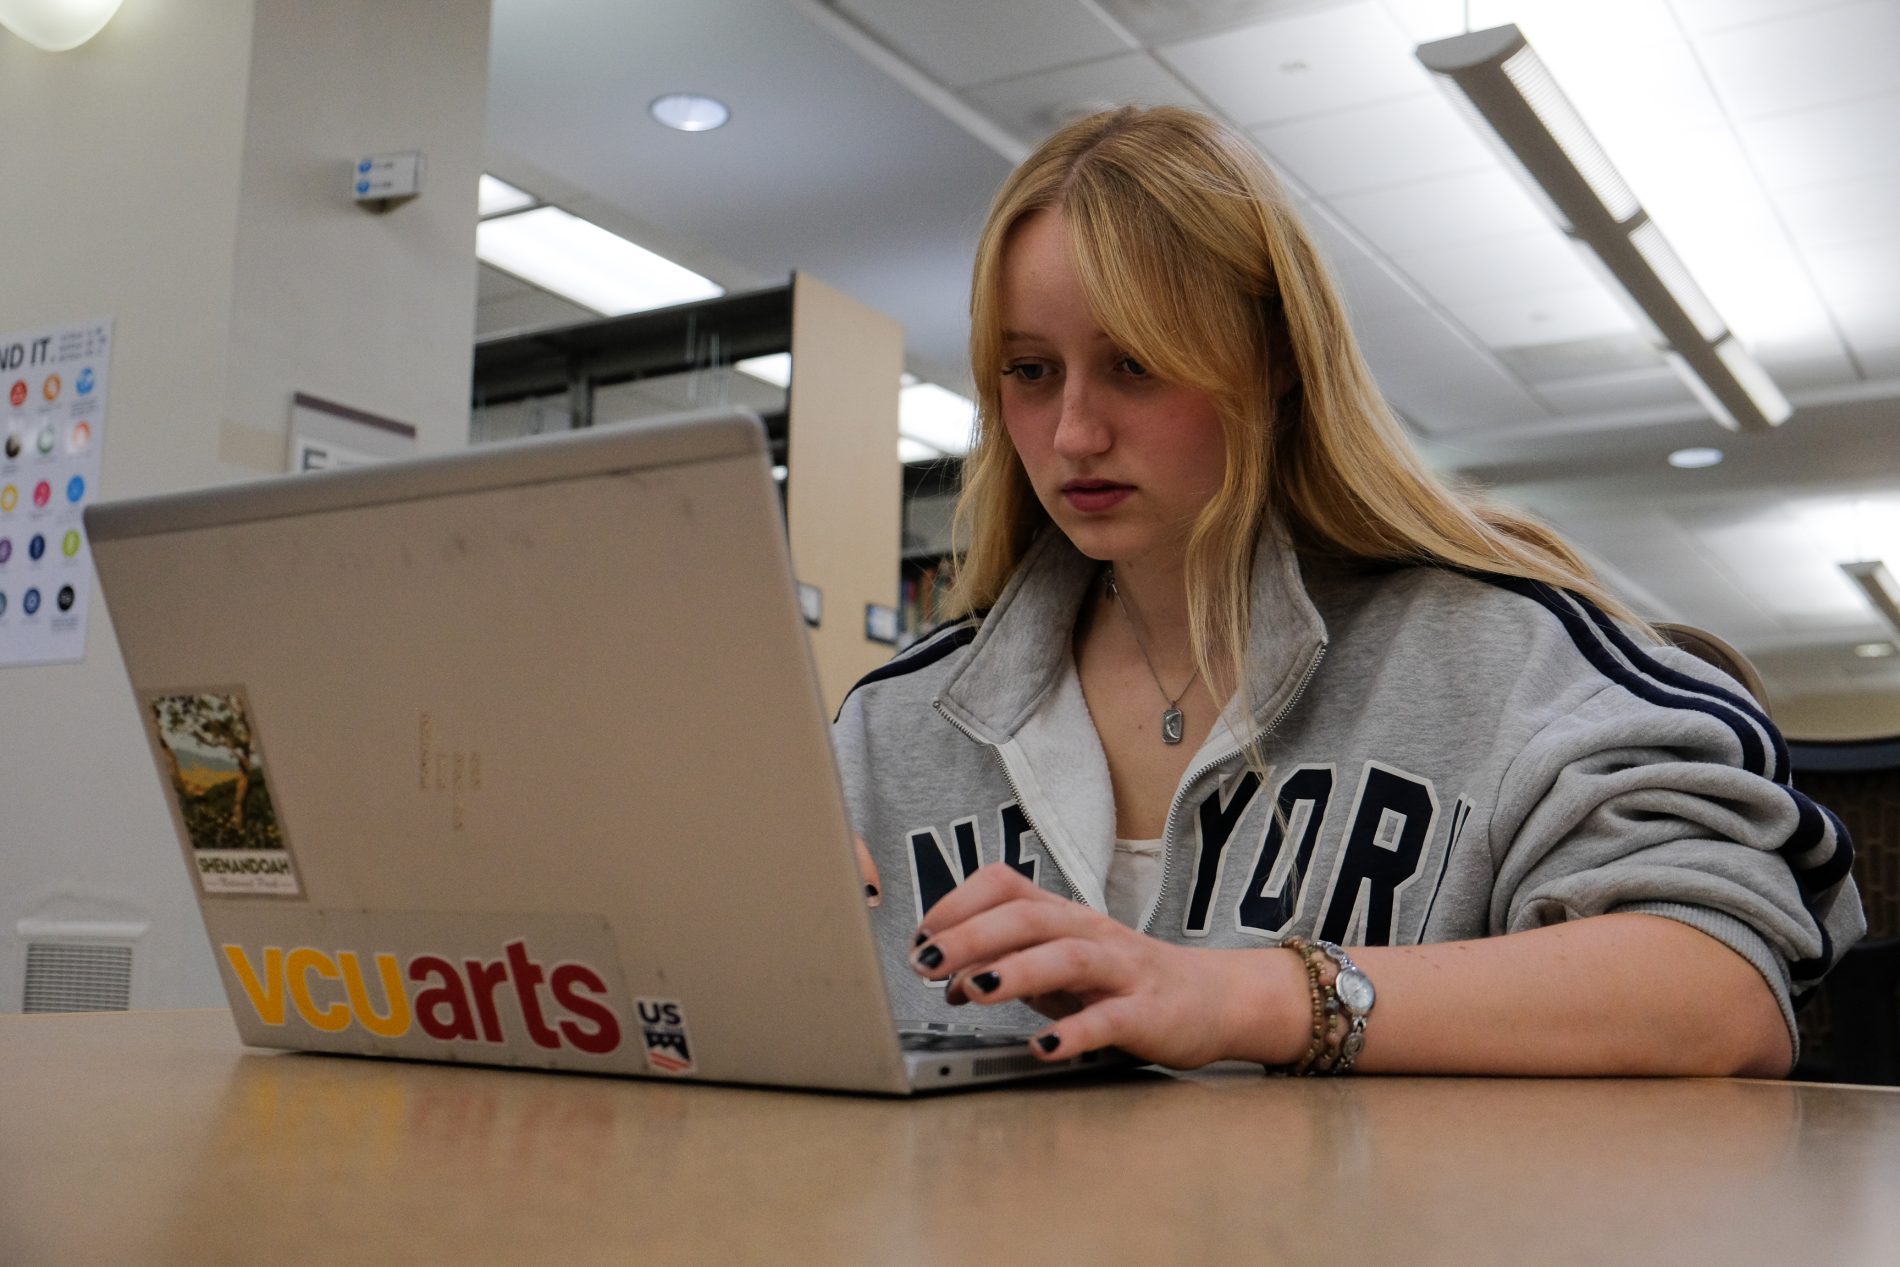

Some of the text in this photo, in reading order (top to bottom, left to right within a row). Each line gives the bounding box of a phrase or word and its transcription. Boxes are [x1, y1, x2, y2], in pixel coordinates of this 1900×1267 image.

[199, 857, 289, 874] SHENANDOAH
[222, 941, 621, 1055] VCUarts
[637, 1002, 681, 1025] US
